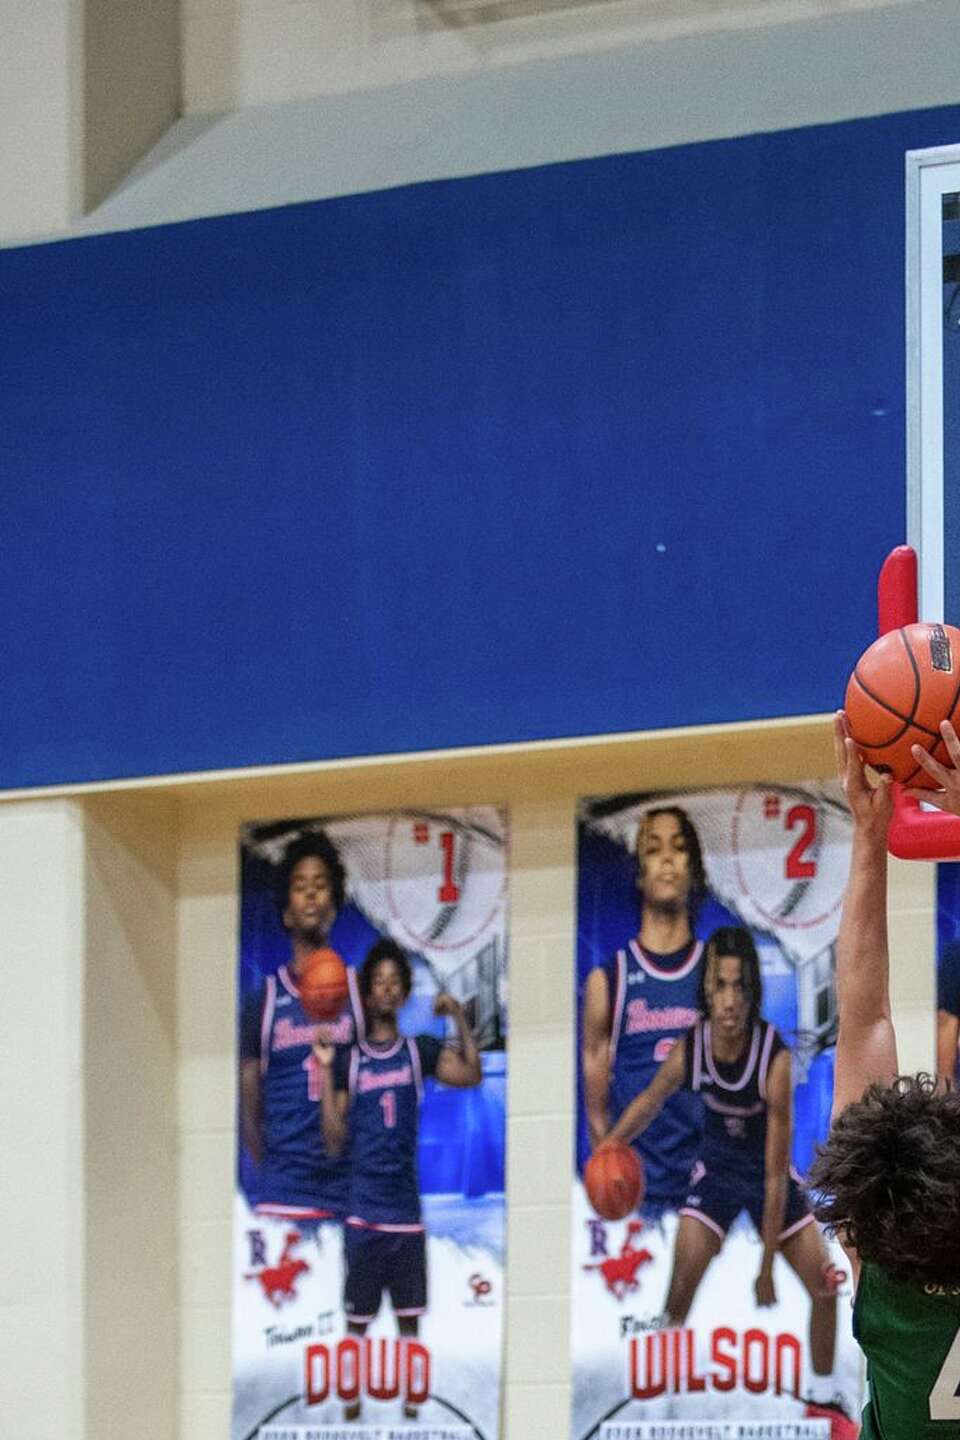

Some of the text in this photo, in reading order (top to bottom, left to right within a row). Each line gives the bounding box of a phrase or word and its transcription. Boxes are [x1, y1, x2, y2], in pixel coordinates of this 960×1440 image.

[379, 1090, 397, 1128] 1
[306, 1337, 430, 1406] DOWD
[630, 1327, 802, 1400] WILSON
